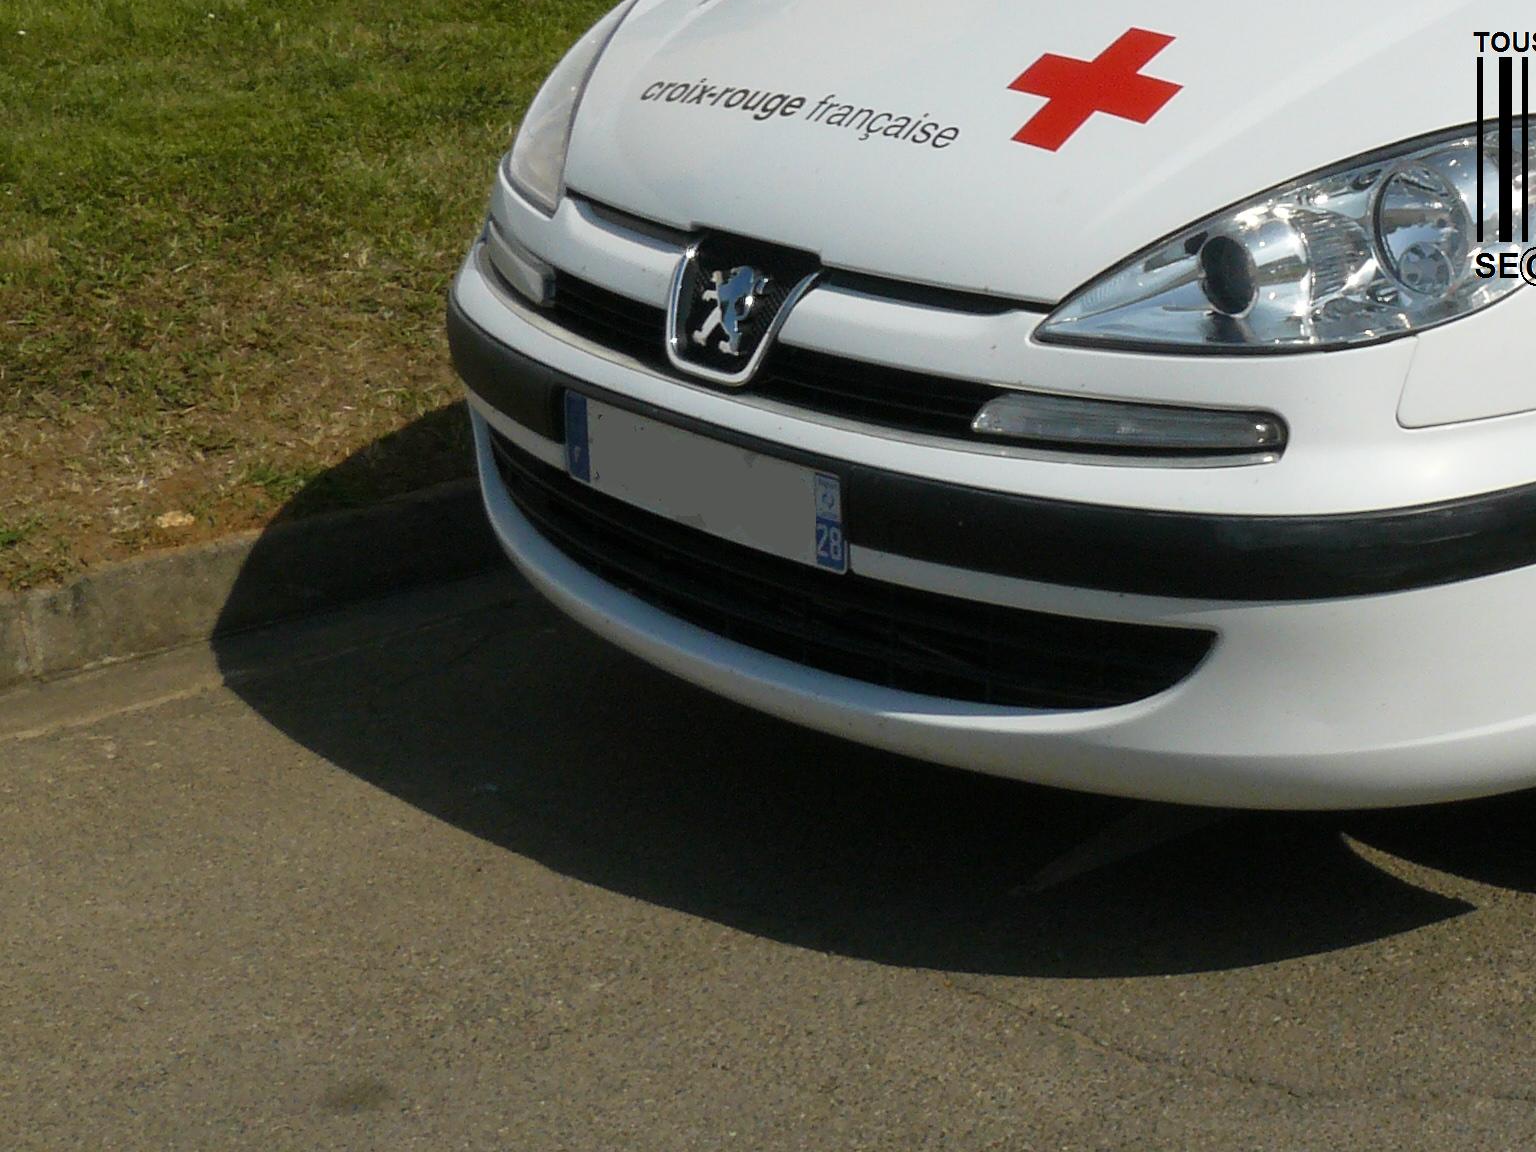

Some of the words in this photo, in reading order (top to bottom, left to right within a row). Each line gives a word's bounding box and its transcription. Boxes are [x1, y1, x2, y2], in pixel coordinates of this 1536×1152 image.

[640, 78, 806, 120] croix-rouge
[804, 94, 960, 149] française
[816, 523, 842, 560] 28
